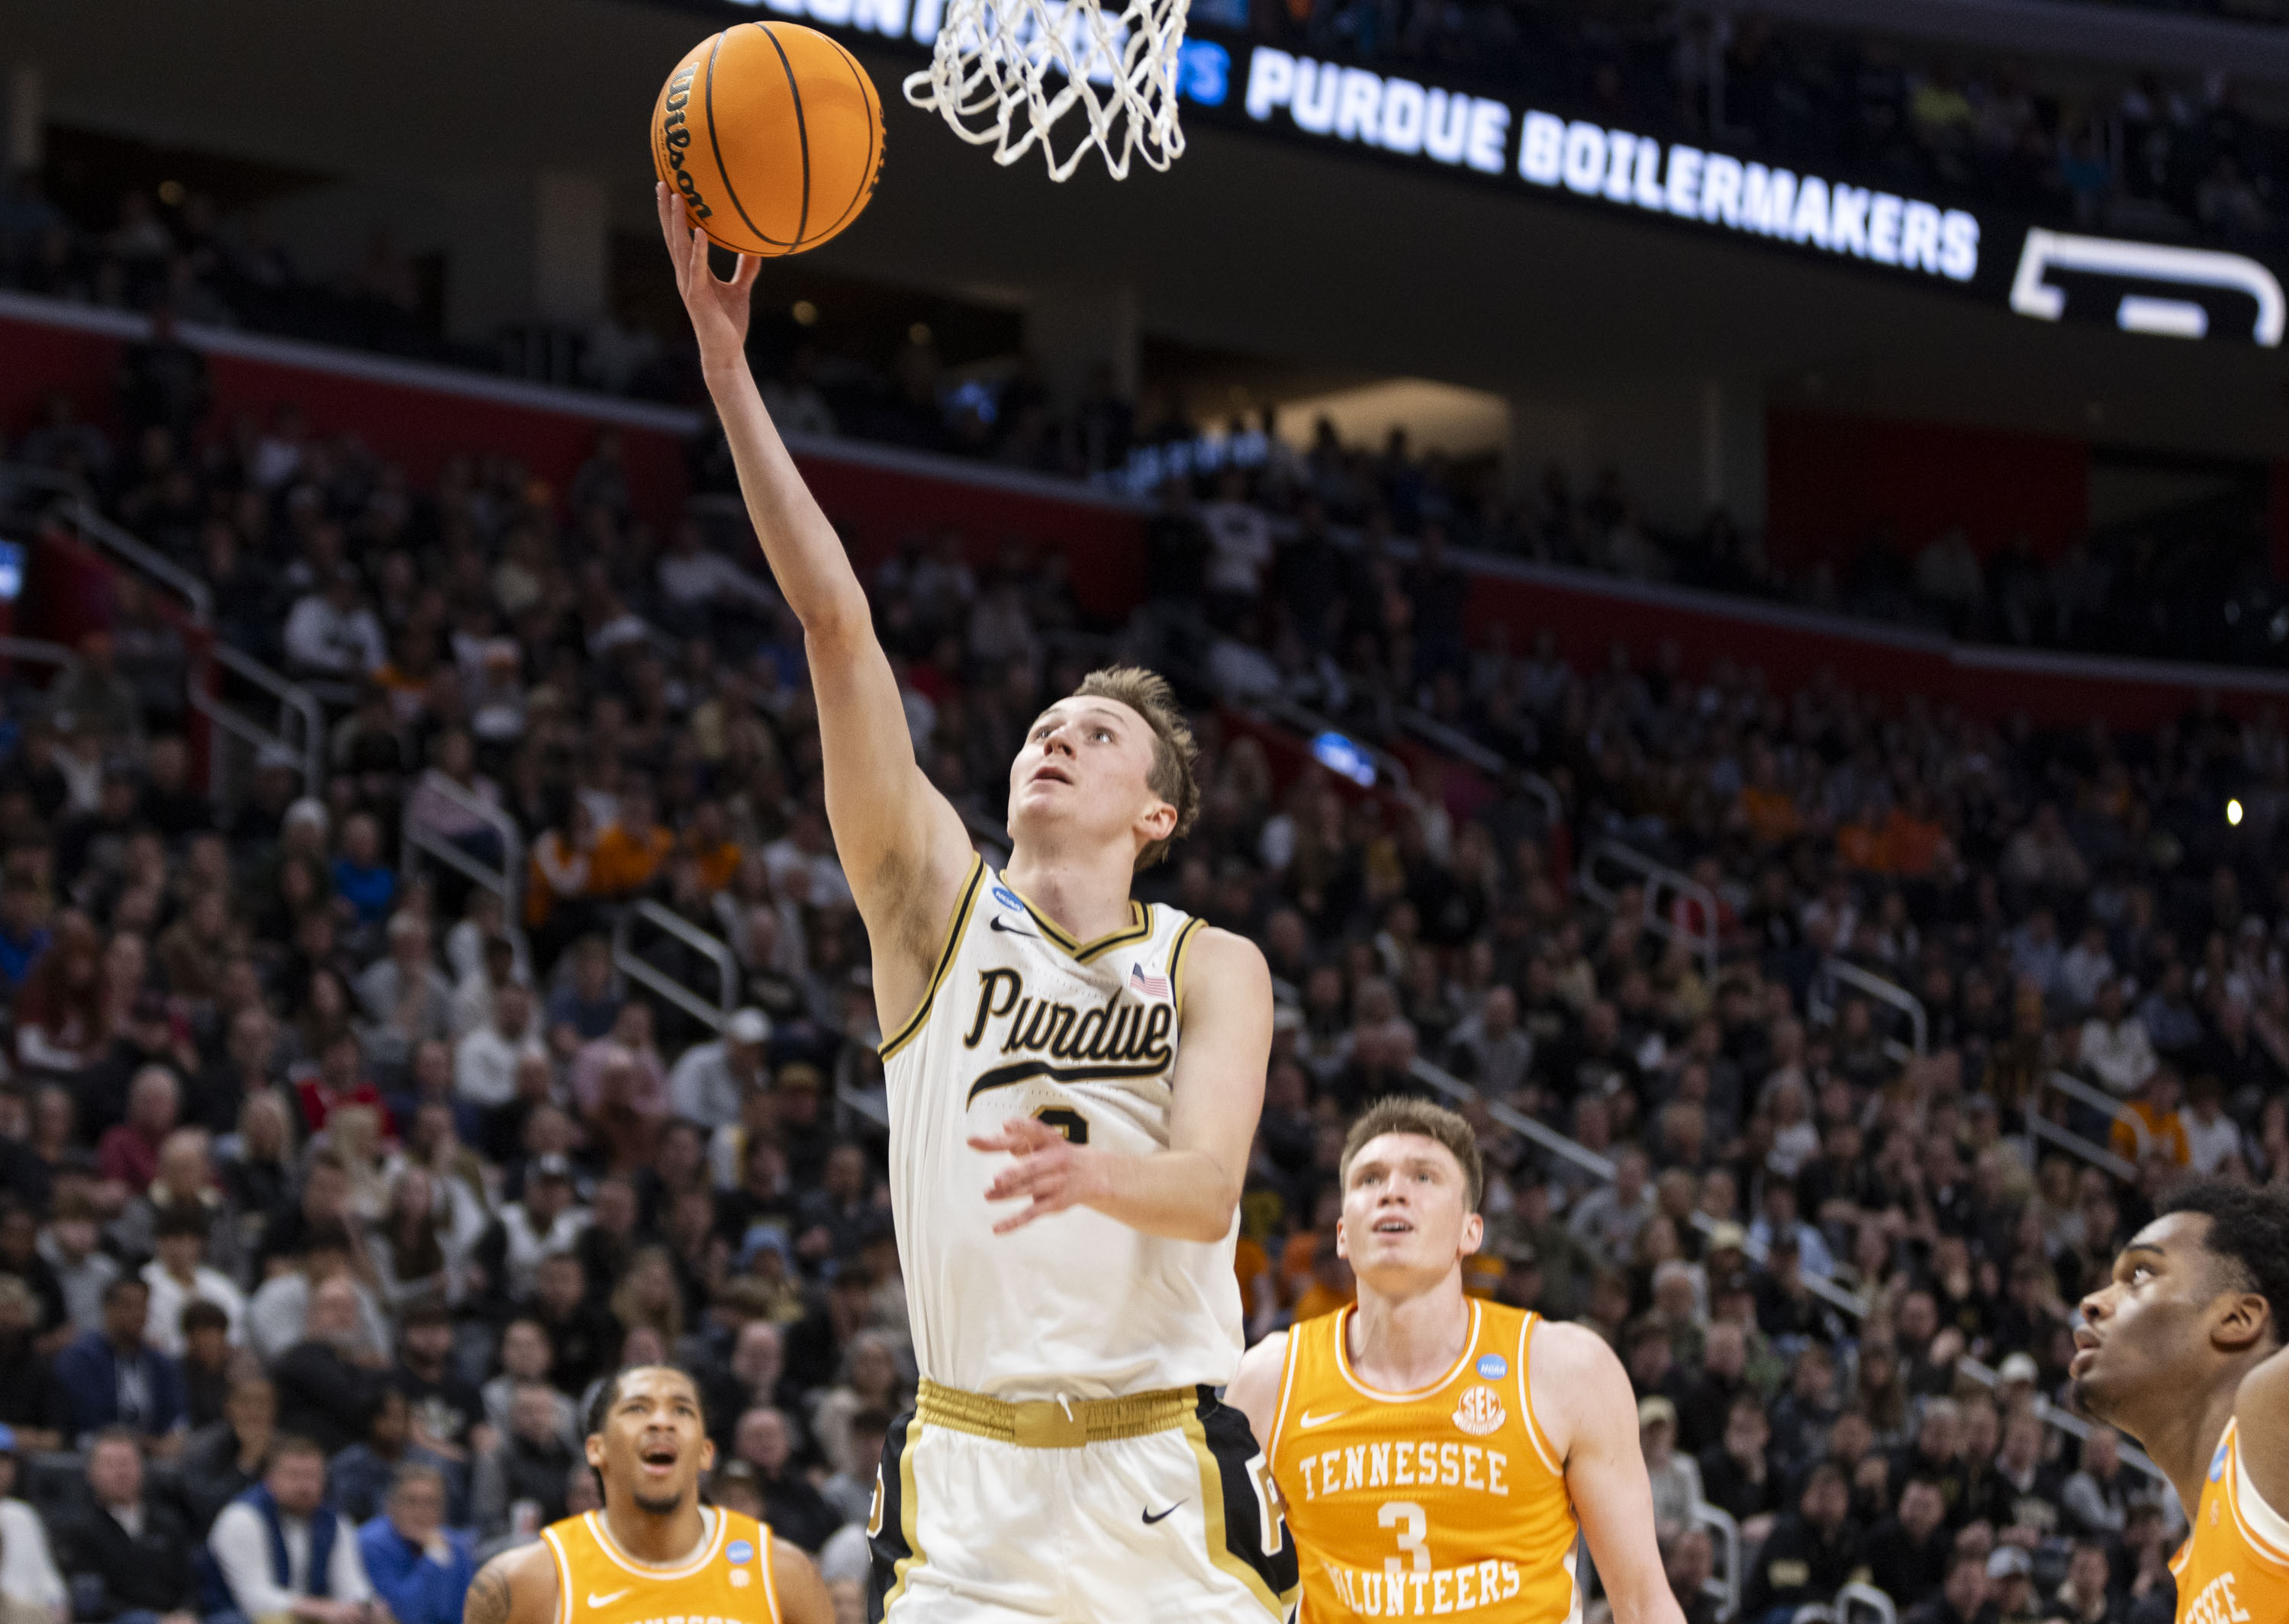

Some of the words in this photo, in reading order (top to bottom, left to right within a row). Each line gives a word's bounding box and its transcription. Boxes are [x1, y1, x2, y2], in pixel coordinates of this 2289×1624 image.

[664, 61, 713, 226] Wilson
[1244, 45, 1512, 175] PURDUE
[1518, 109, 1981, 281] BOILERMAKERS
[963, 966, 1173, 1082] Purdue
[1462, 1385, 1499, 1422] SEC
[1299, 1441, 1509, 1501] TENNESSEE
[1377, 1501, 1431, 1573] 3
